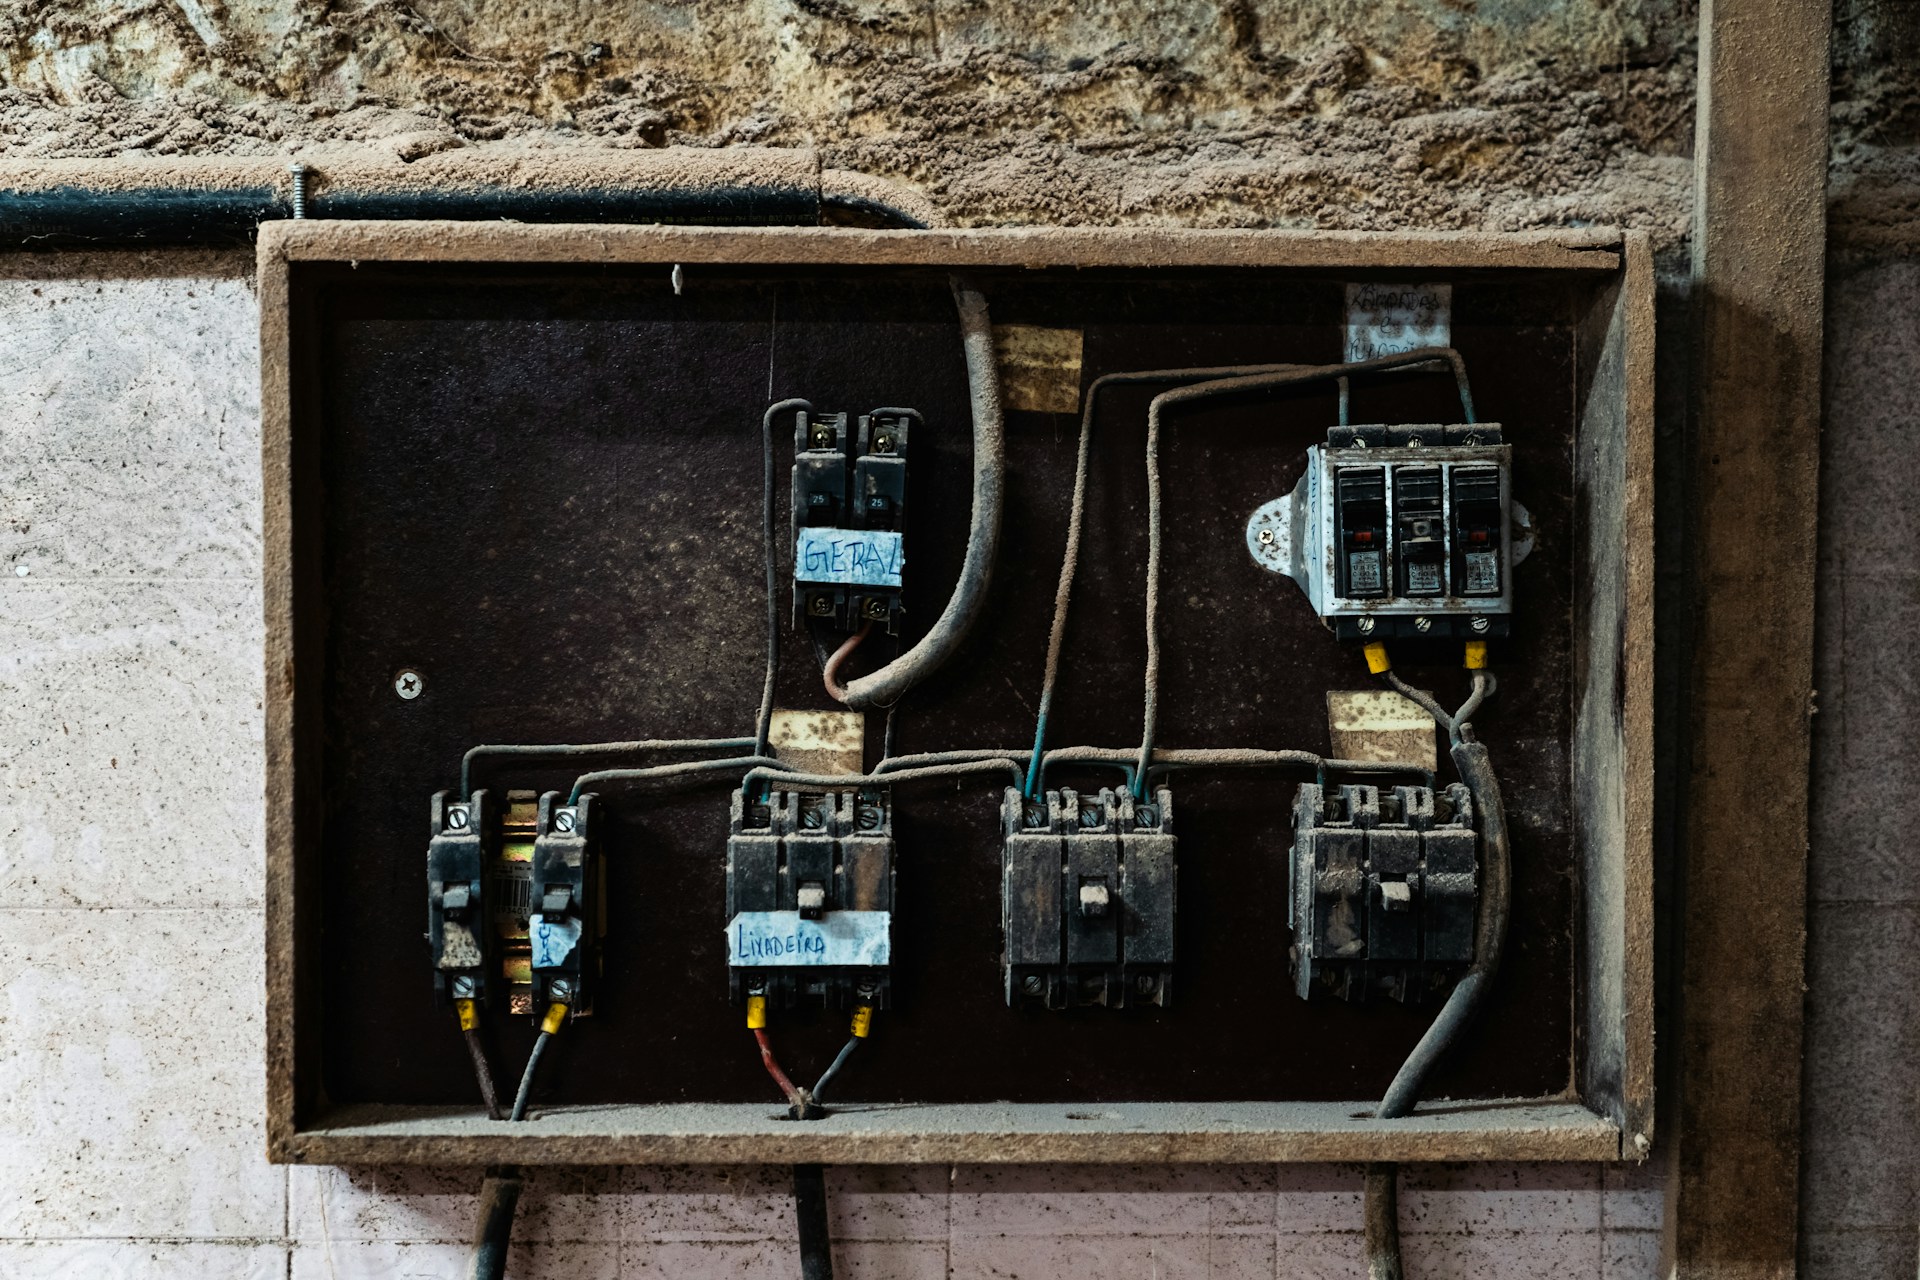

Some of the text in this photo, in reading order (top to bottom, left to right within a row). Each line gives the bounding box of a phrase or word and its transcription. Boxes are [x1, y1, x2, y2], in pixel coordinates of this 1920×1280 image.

[813, 495, 825, 504] 25
[871, 498, 883, 507] 25
[804, 537, 901, 576] GERAL
